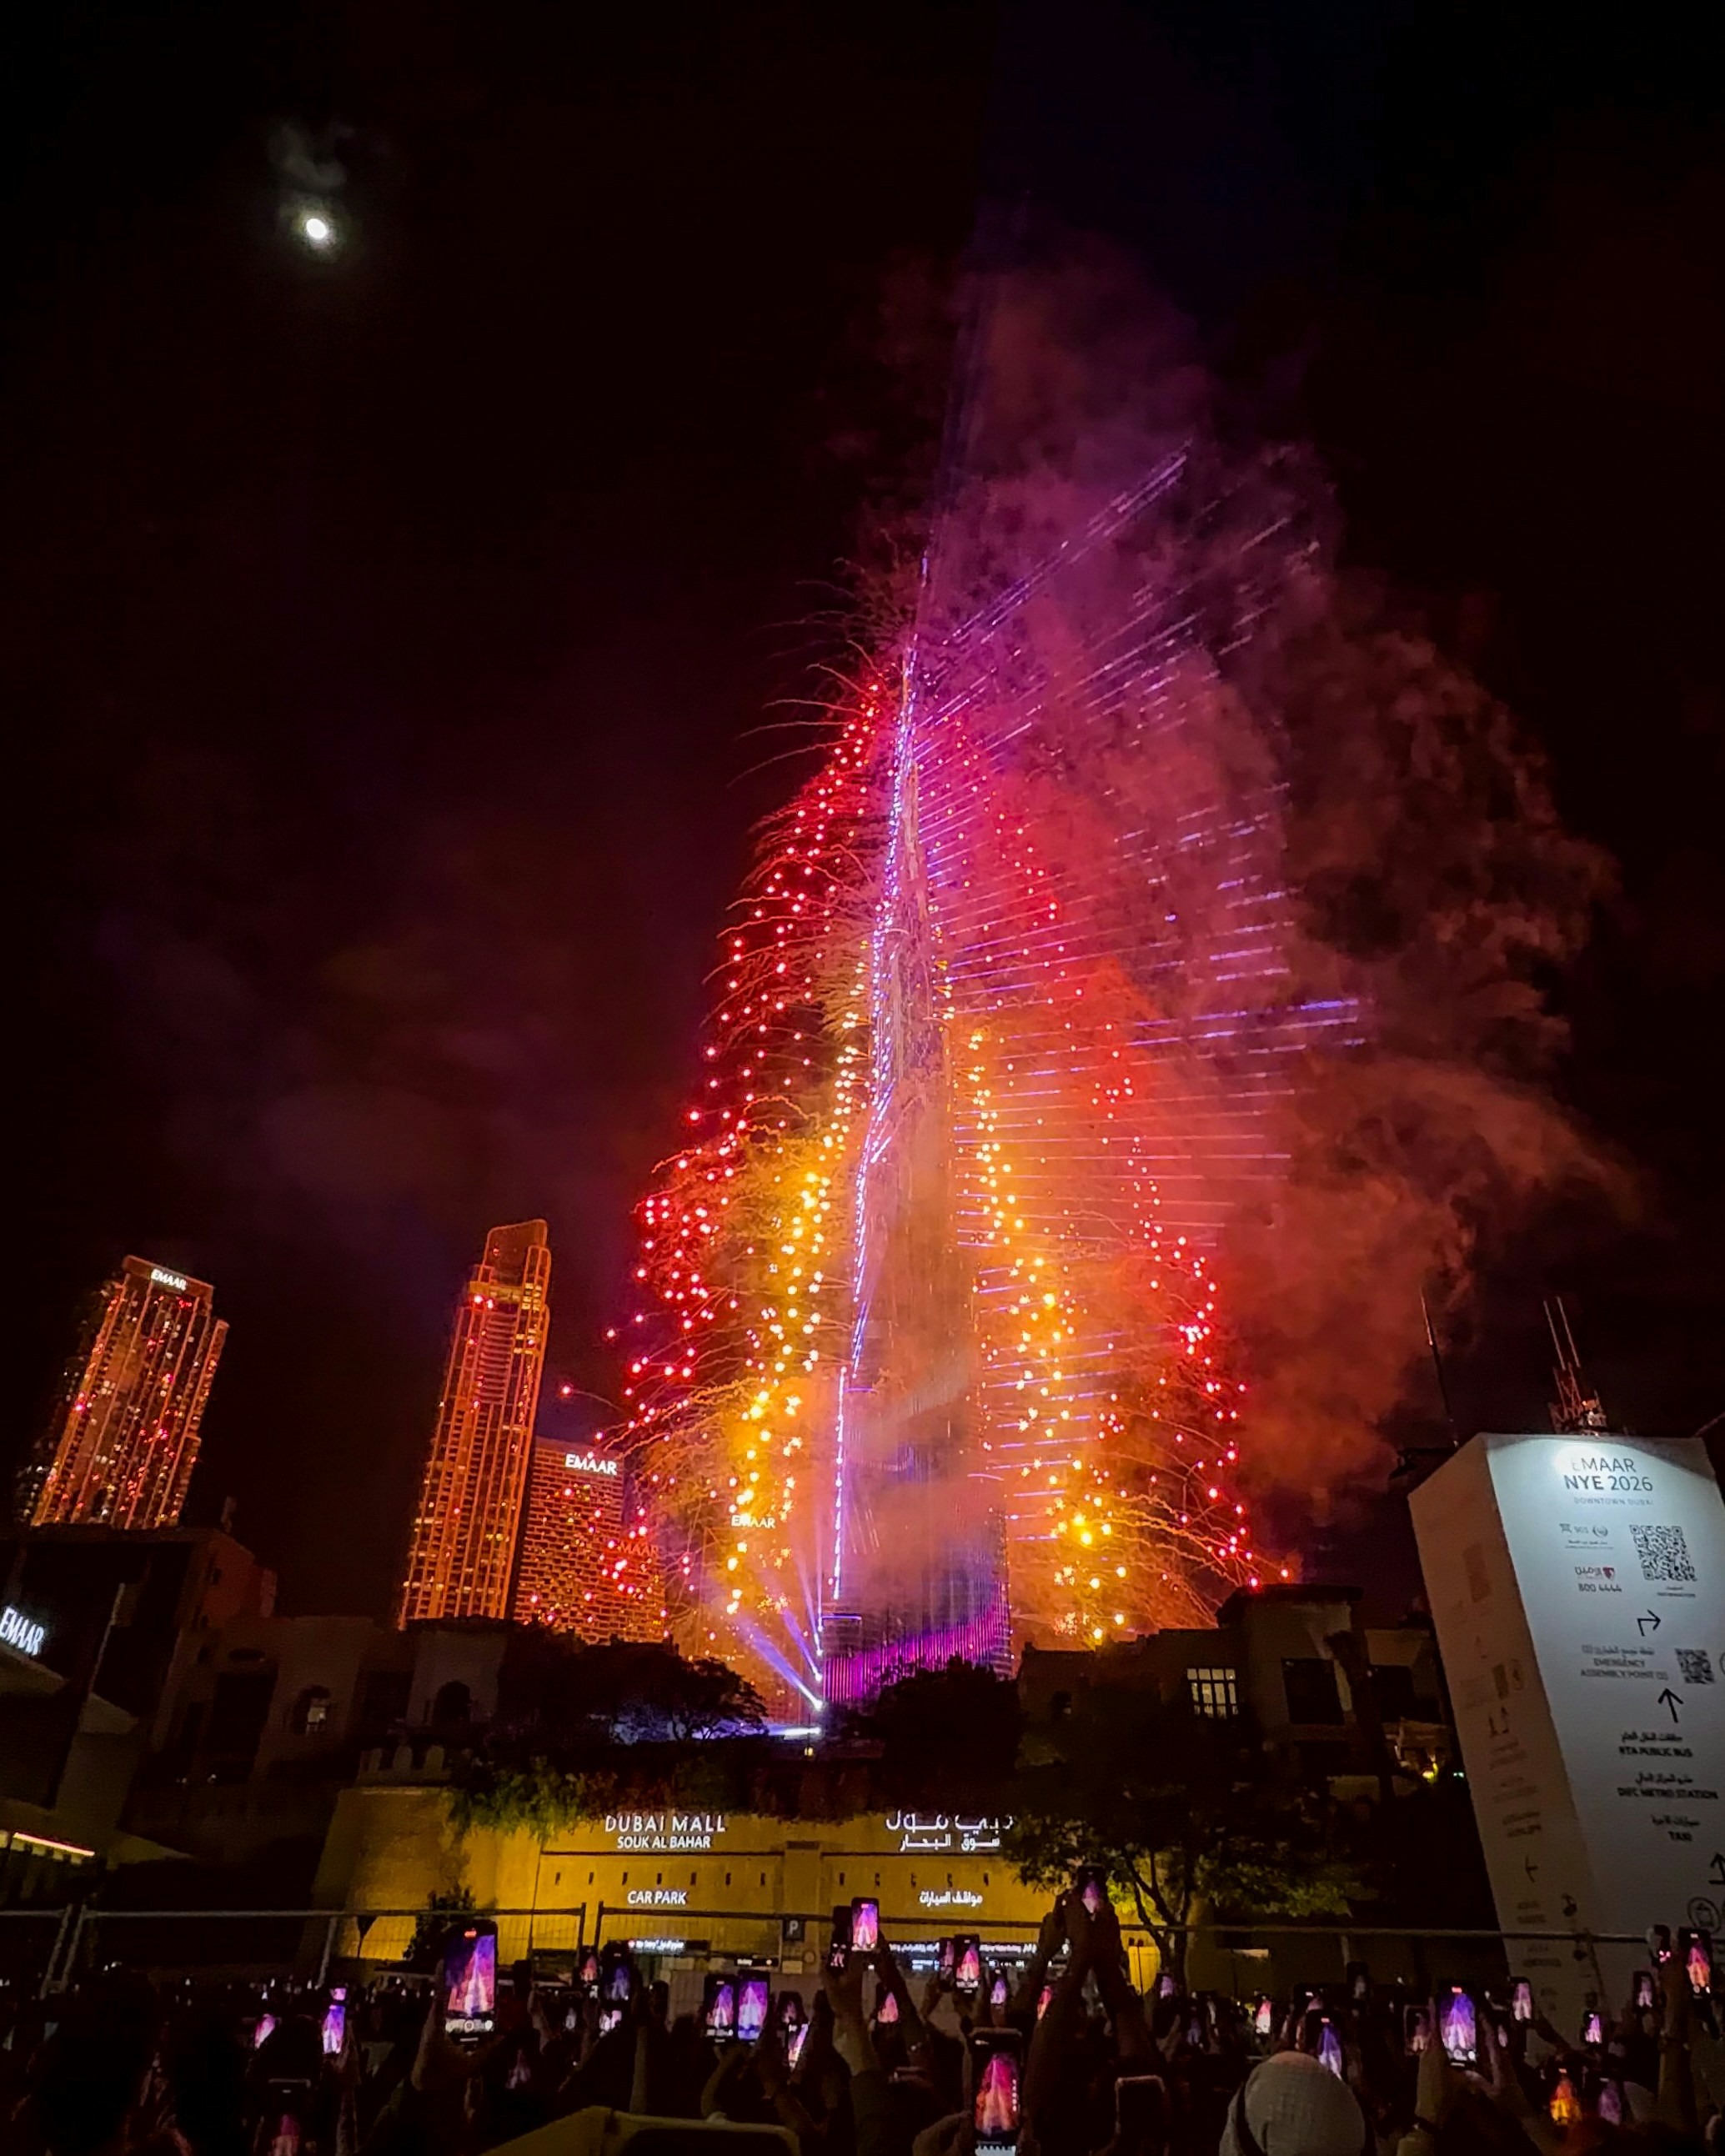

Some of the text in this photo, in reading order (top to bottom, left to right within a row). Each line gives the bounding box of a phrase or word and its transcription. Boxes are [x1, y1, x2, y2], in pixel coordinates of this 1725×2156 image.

[151, 1268, 187, 1291] EMAAR
[564, 1453, 618, 1476] EMAAR
[1564, 1475, 1653, 1491] NYE 2026
[618, 1540, 659, 1560] MAAR
[1578, 1582, 1597, 1592] 800
[0, 1607, 44, 1657] EMAAR
[604, 1814, 725, 1833] DUBAI MALL
[885, 1809, 949, 1833] مول
[617, 1836, 710, 1848] SOUK AL BAHAR
[900, 1833, 1000, 1852] سوق البحار
[627, 1890, 687, 1905] CAR PARK
[919, 1889, 983, 1907] مواقف السيارات
[789, 1920, 799, 1935] P
